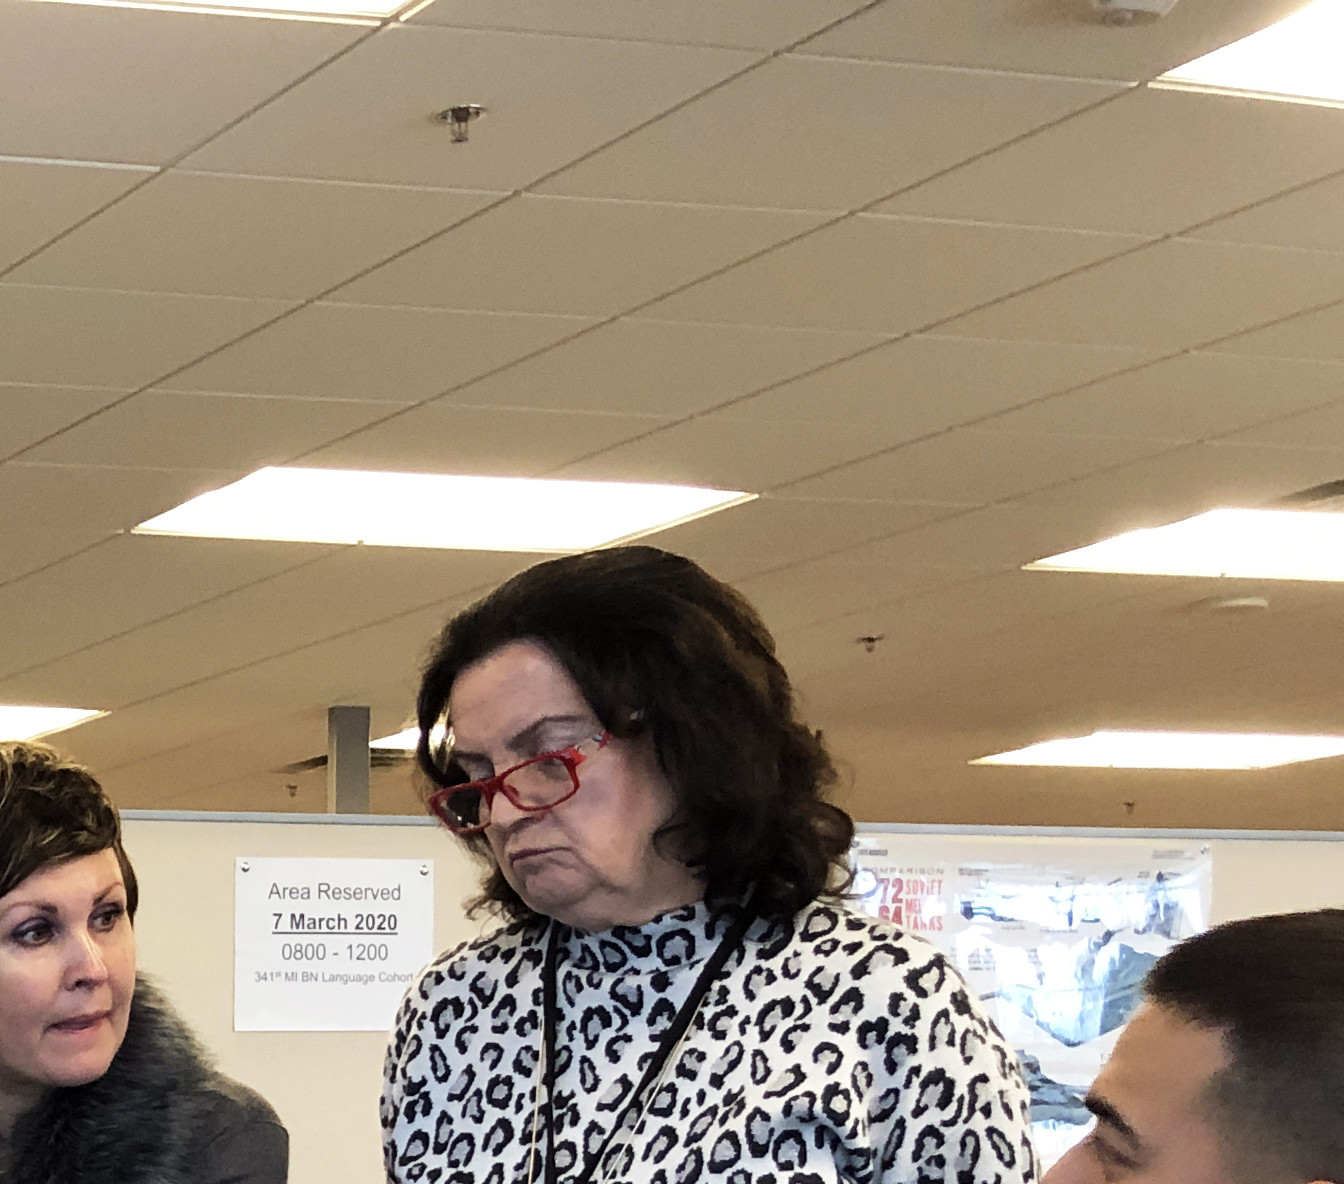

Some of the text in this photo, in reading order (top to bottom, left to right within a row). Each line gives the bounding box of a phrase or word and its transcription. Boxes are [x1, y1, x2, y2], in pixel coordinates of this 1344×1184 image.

[268, 883, 400, 900] Area Reserved
[273, 913, 397, 930] 7 March 2020
[282, 943, 326, 960] 0800
[346, 943, 389, 961] 1200
[285, 972, 297, 982] MI
[302, 971, 318, 982] BN
[322, 972, 375, 985] Language
[379, 972, 413, 982] Cohort
